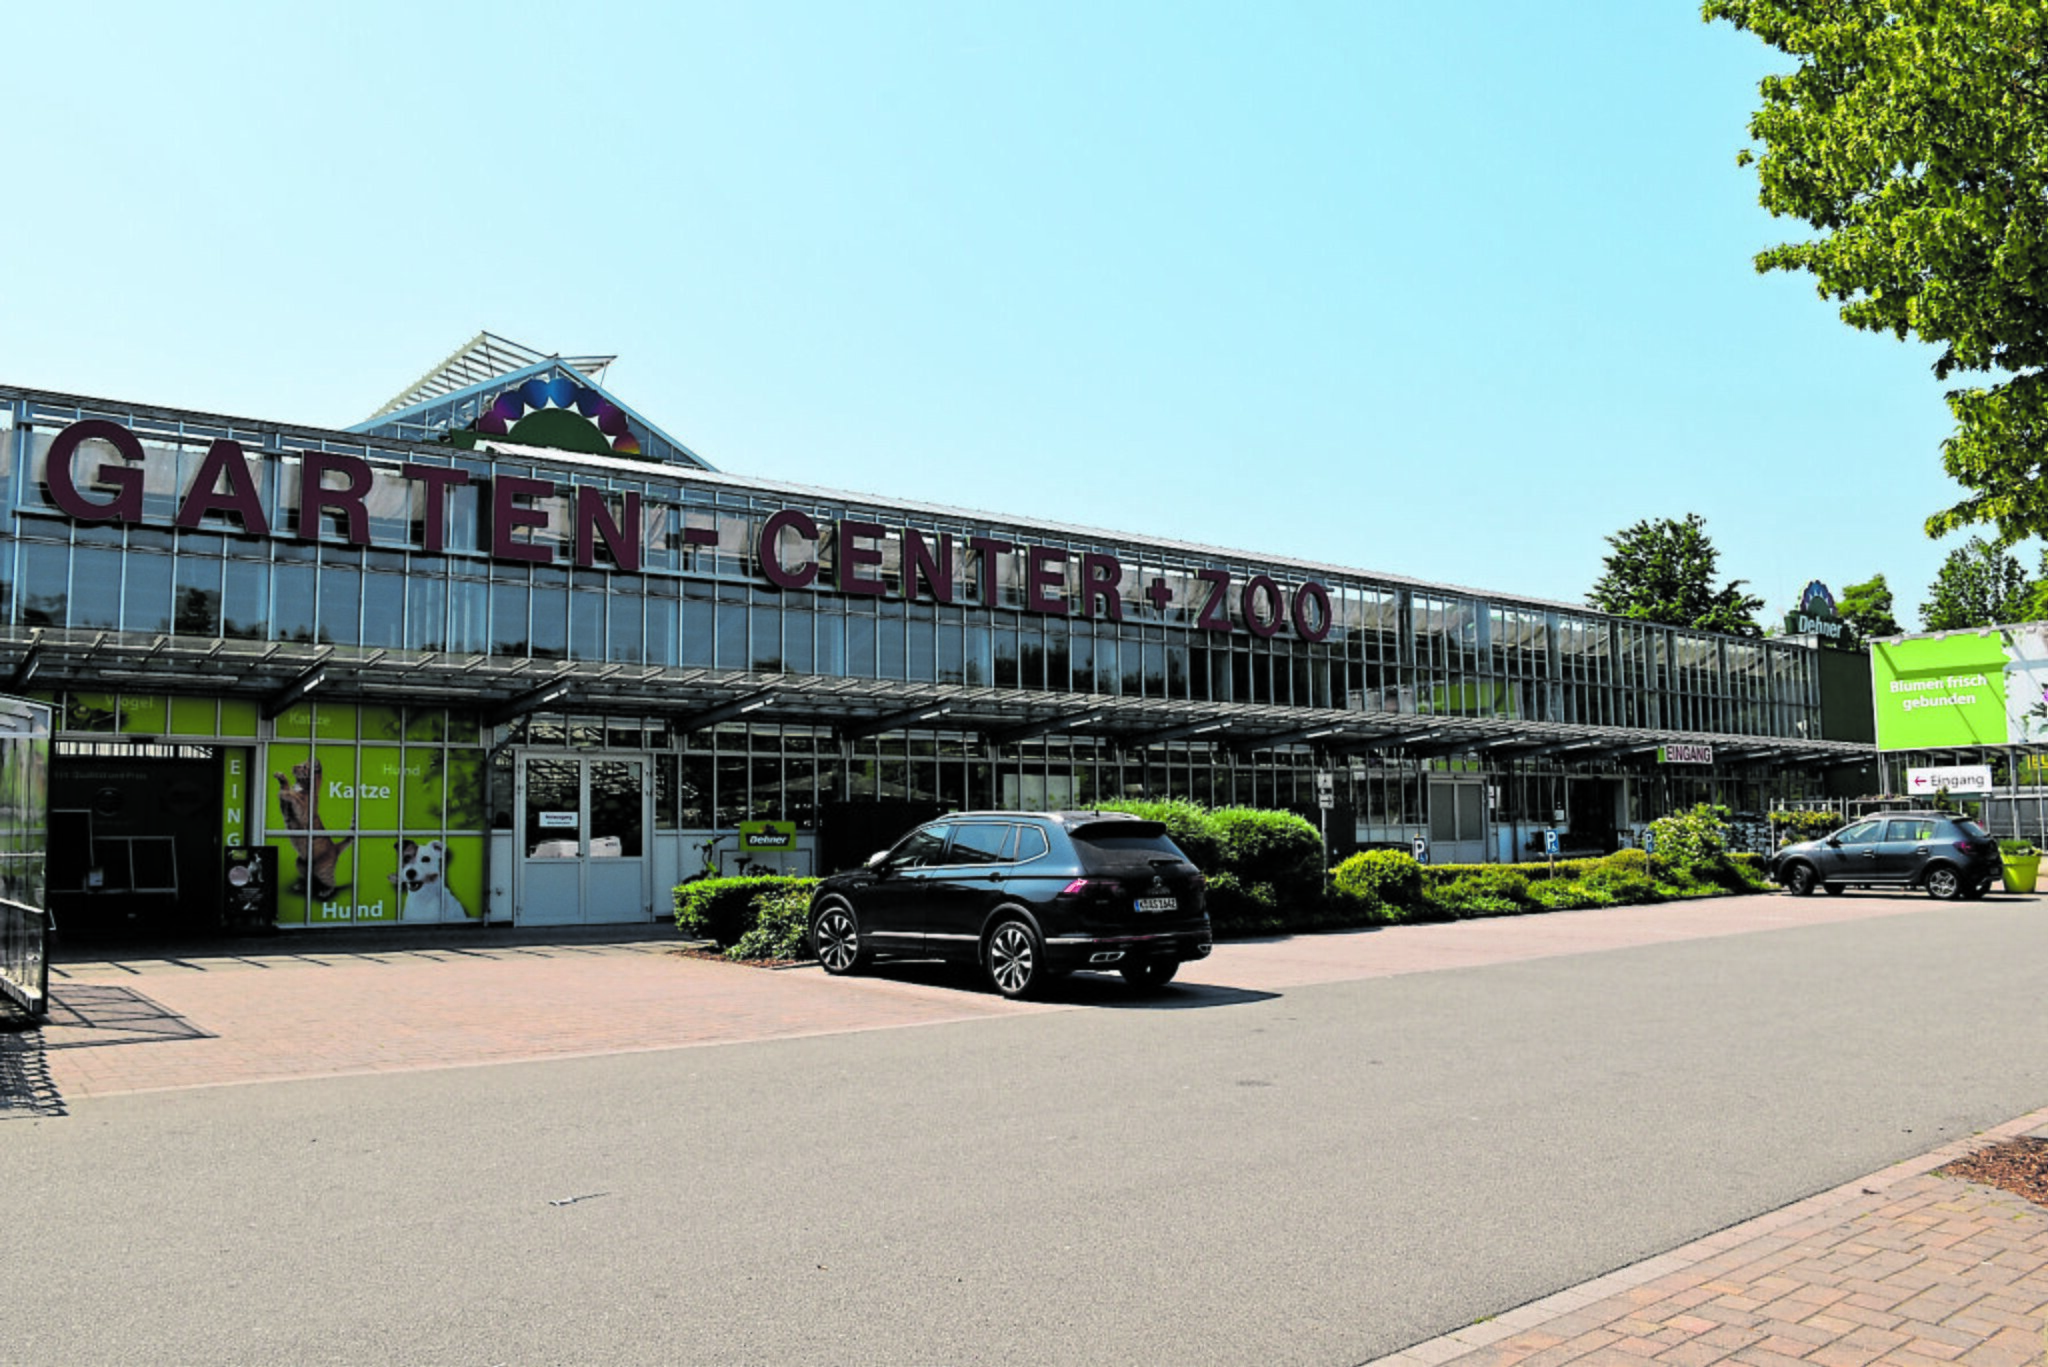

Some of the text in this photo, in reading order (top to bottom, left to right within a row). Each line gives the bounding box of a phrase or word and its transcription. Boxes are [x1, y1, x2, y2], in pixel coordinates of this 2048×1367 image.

[46, 418, 641, 571] GARTEN
[759, 508, 1123, 621] CENTER
[1195, 568, 1333, 643] ZOO
[1798, 614, 1842, 639] Dehner
[1889, 674, 1988, 693] Blumen frisch
[105, 694, 153, 711] Vogel
[1903, 693, 1977, 712] gebunden
[289, 711, 331, 726] Katze
[1665, 745, 1711, 762] EINGANG
[383, 763, 420, 777] Hund
[329, 781, 391, 799] Katze
[1930, 774, 1985, 788] Eingang
[749, 835, 787, 845] Dehner
[1547, 831, 1557, 851] P
[1414, 840, 1425, 861] P
[322, 900, 383, 919] Hund
